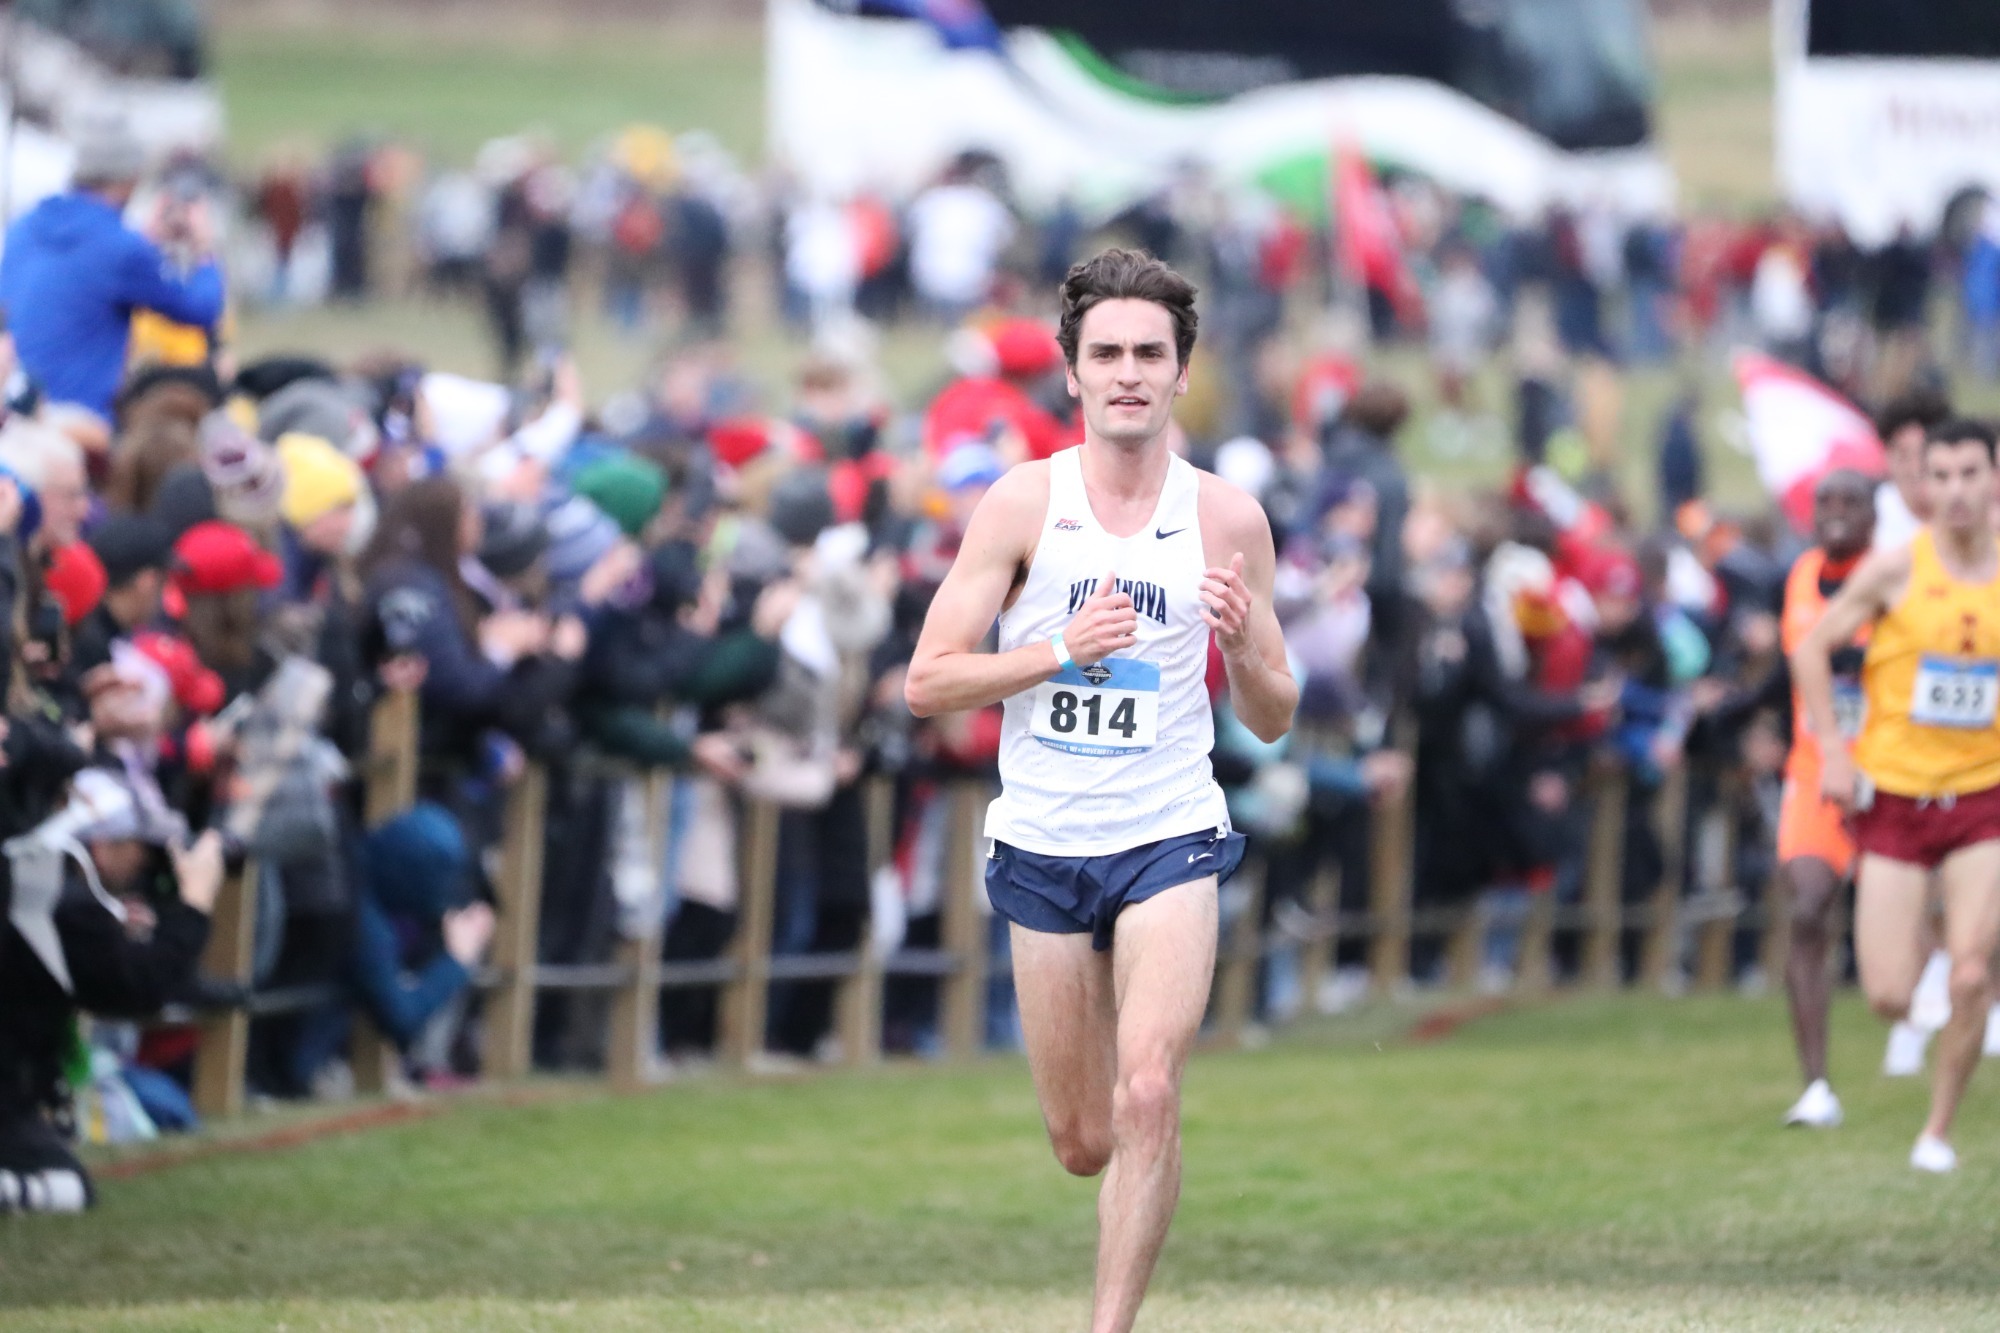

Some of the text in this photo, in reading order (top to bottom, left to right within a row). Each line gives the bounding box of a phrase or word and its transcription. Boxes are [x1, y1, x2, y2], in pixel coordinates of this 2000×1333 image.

[1067, 578, 1166, 625] VINOVA
[1050, 691, 1137, 738] 814
[1081, 747, 1114, 755] NOVEMBER
